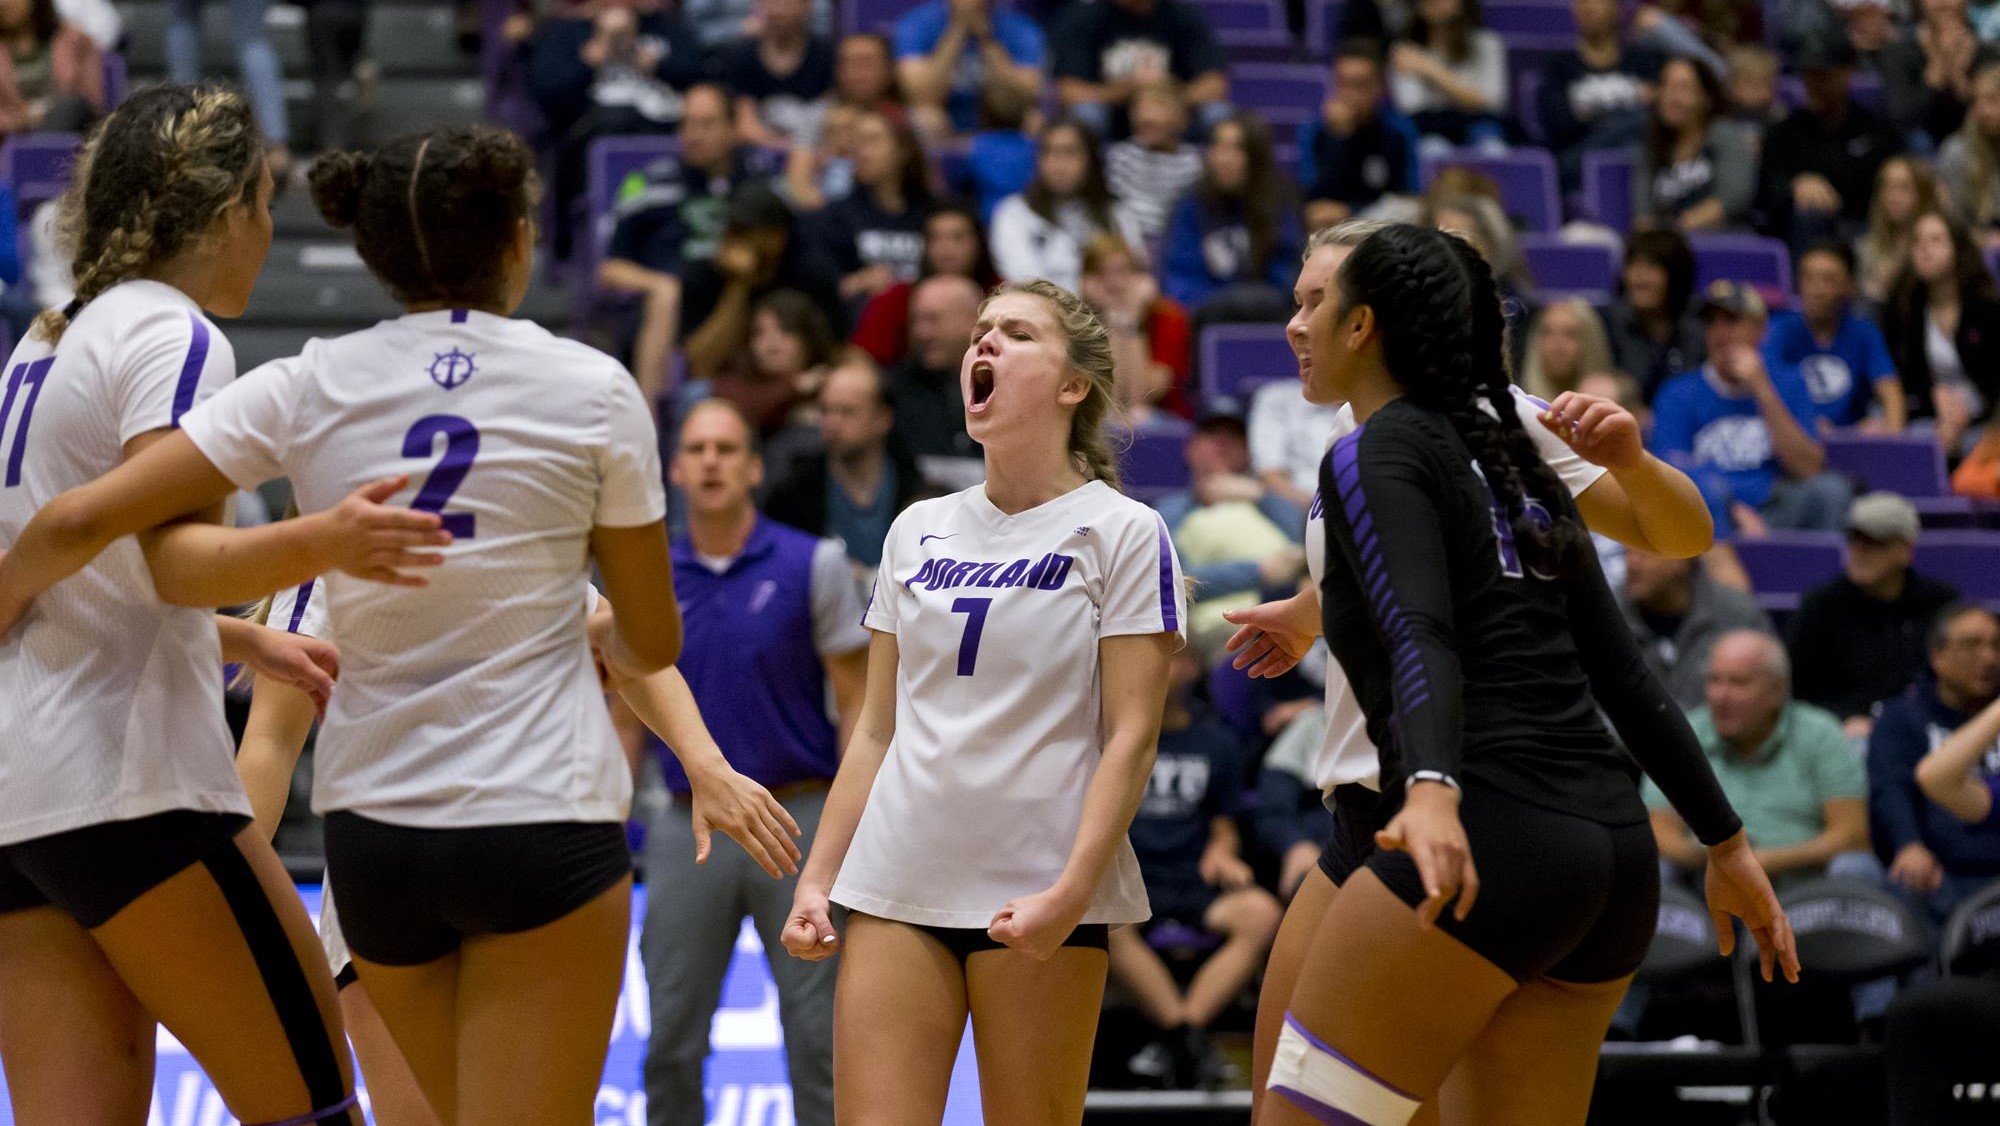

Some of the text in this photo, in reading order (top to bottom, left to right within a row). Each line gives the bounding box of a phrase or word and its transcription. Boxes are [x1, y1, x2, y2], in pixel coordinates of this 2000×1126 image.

[0, 355, 57, 488] 17
[401, 413, 480, 539] 2
[905, 552, 1074, 591] PORTLAND
[951, 598, 993, 676] 7
